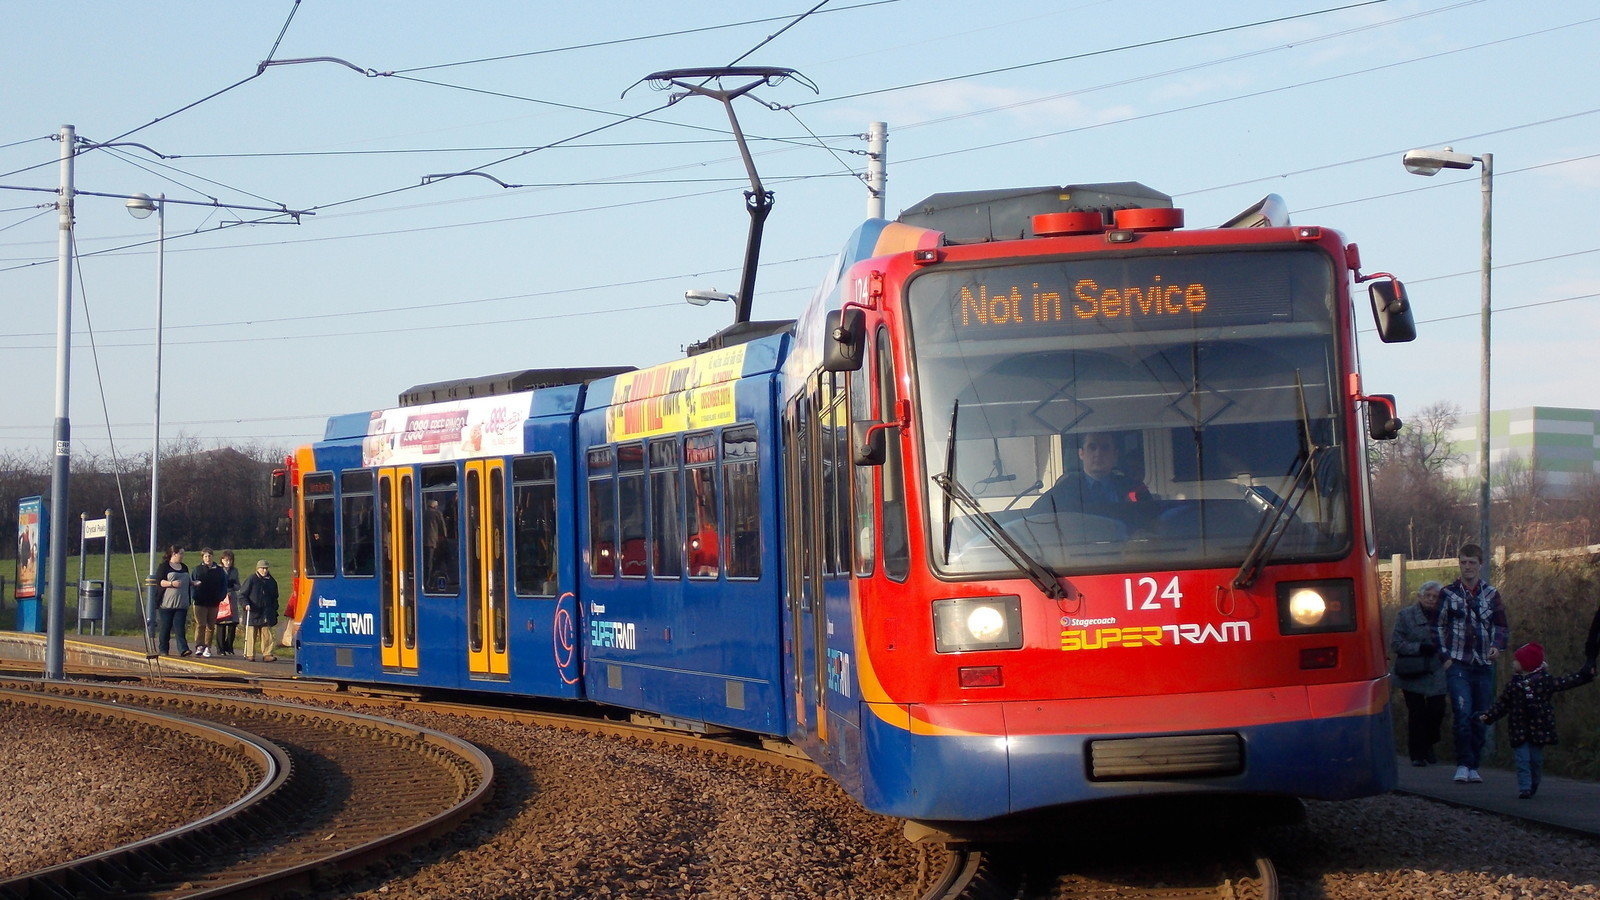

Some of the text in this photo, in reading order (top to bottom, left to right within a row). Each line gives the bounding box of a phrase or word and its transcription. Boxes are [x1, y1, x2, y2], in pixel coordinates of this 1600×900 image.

[960, 275, 1208, 326] Not in Service
[1124, 575, 1183, 611] 124
[1061, 621, 1252, 651] SUPERTRAM
[1071, 616, 1117, 628] Stagecoach
